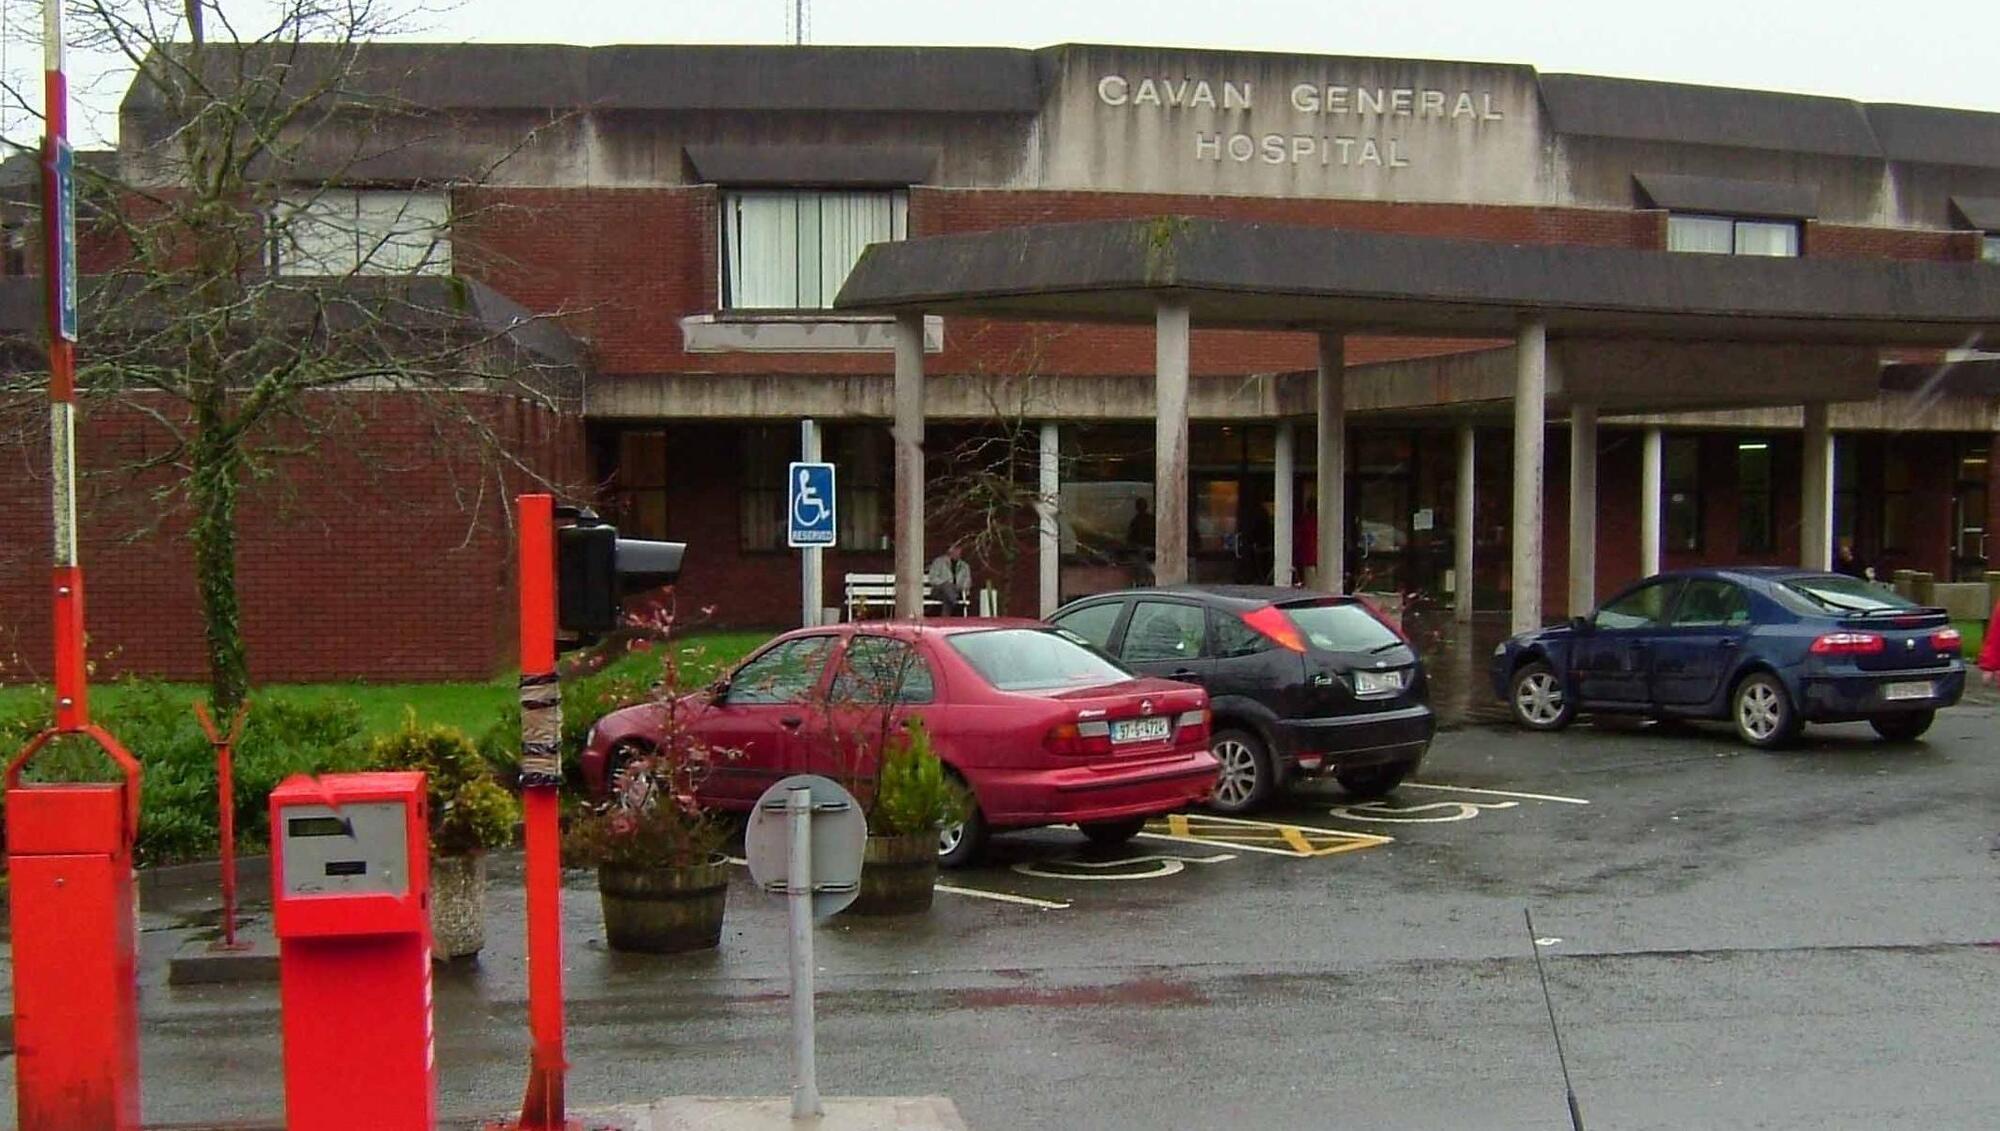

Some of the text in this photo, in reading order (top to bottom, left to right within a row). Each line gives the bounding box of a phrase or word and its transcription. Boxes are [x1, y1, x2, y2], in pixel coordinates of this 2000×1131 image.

[1097, 75, 1504, 121] CAVAN GENERAL
[1195, 131, 1410, 168] HOSPITAL
